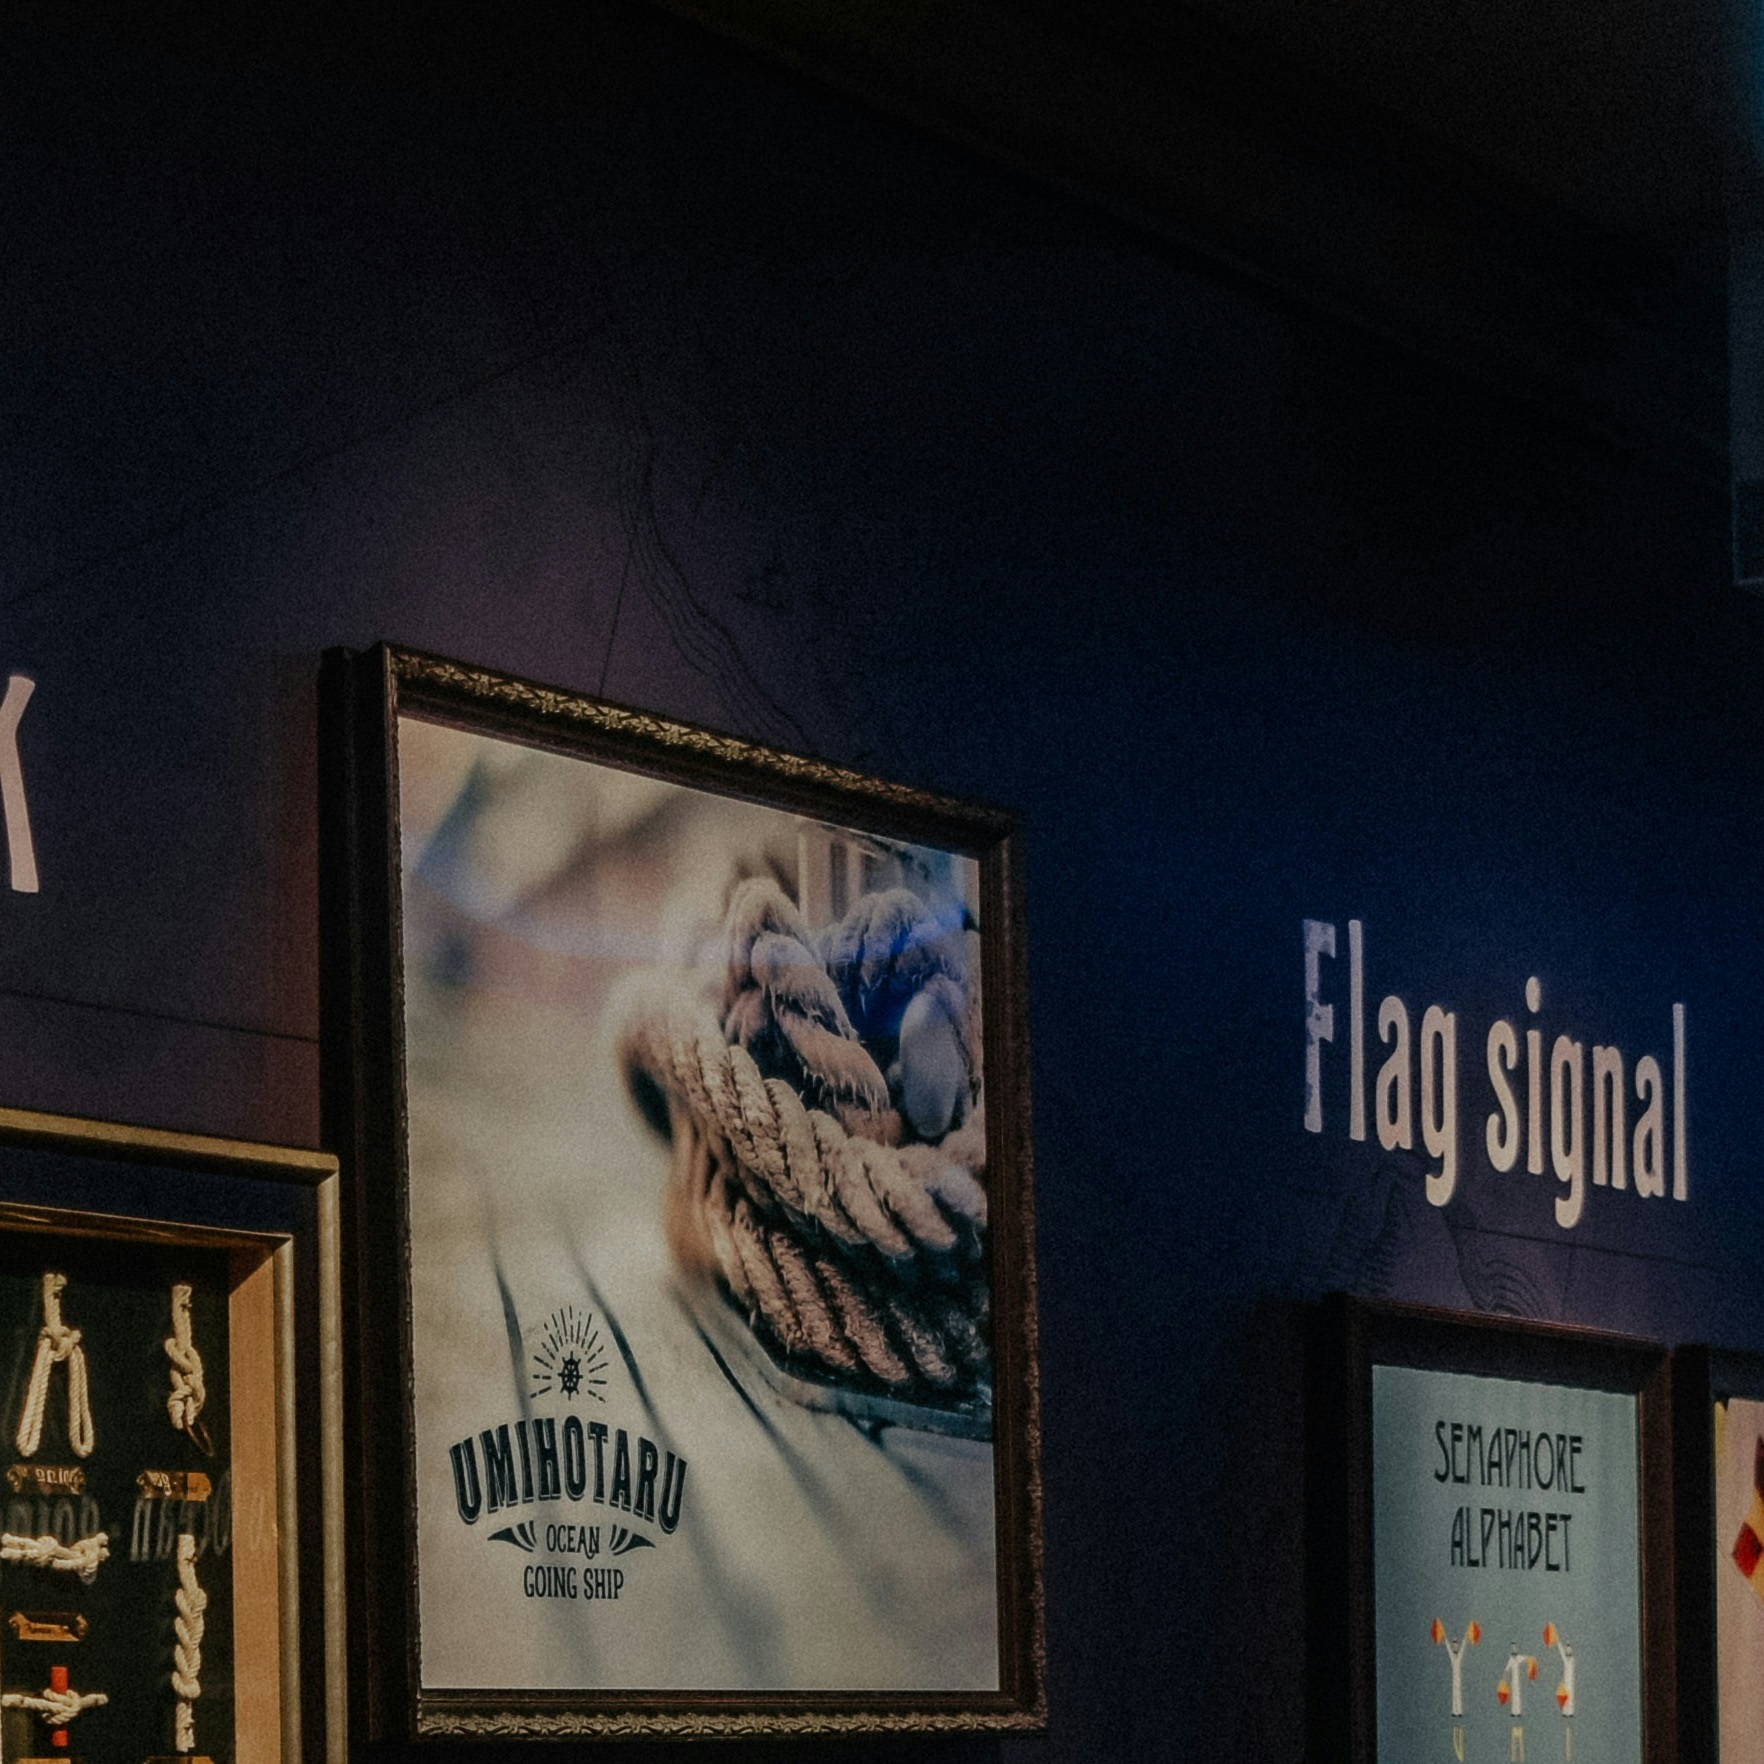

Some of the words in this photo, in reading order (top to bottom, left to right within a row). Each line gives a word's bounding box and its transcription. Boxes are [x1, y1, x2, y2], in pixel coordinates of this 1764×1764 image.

[1303, 918, 1457, 1207] Flag
[1485, 975, 1688, 1229] signal
[449, 1415, 687, 1534] UMIHOTARU
[1433, 1420, 1585, 1494] SEMAPHORE
[546, 1524, 600, 1559] OCEAN
[1450, 1506, 1572, 1572] ALPHABET
[524, 1566, 577, 1599] GOING
[584, 1567, 624, 1600] SHIP
